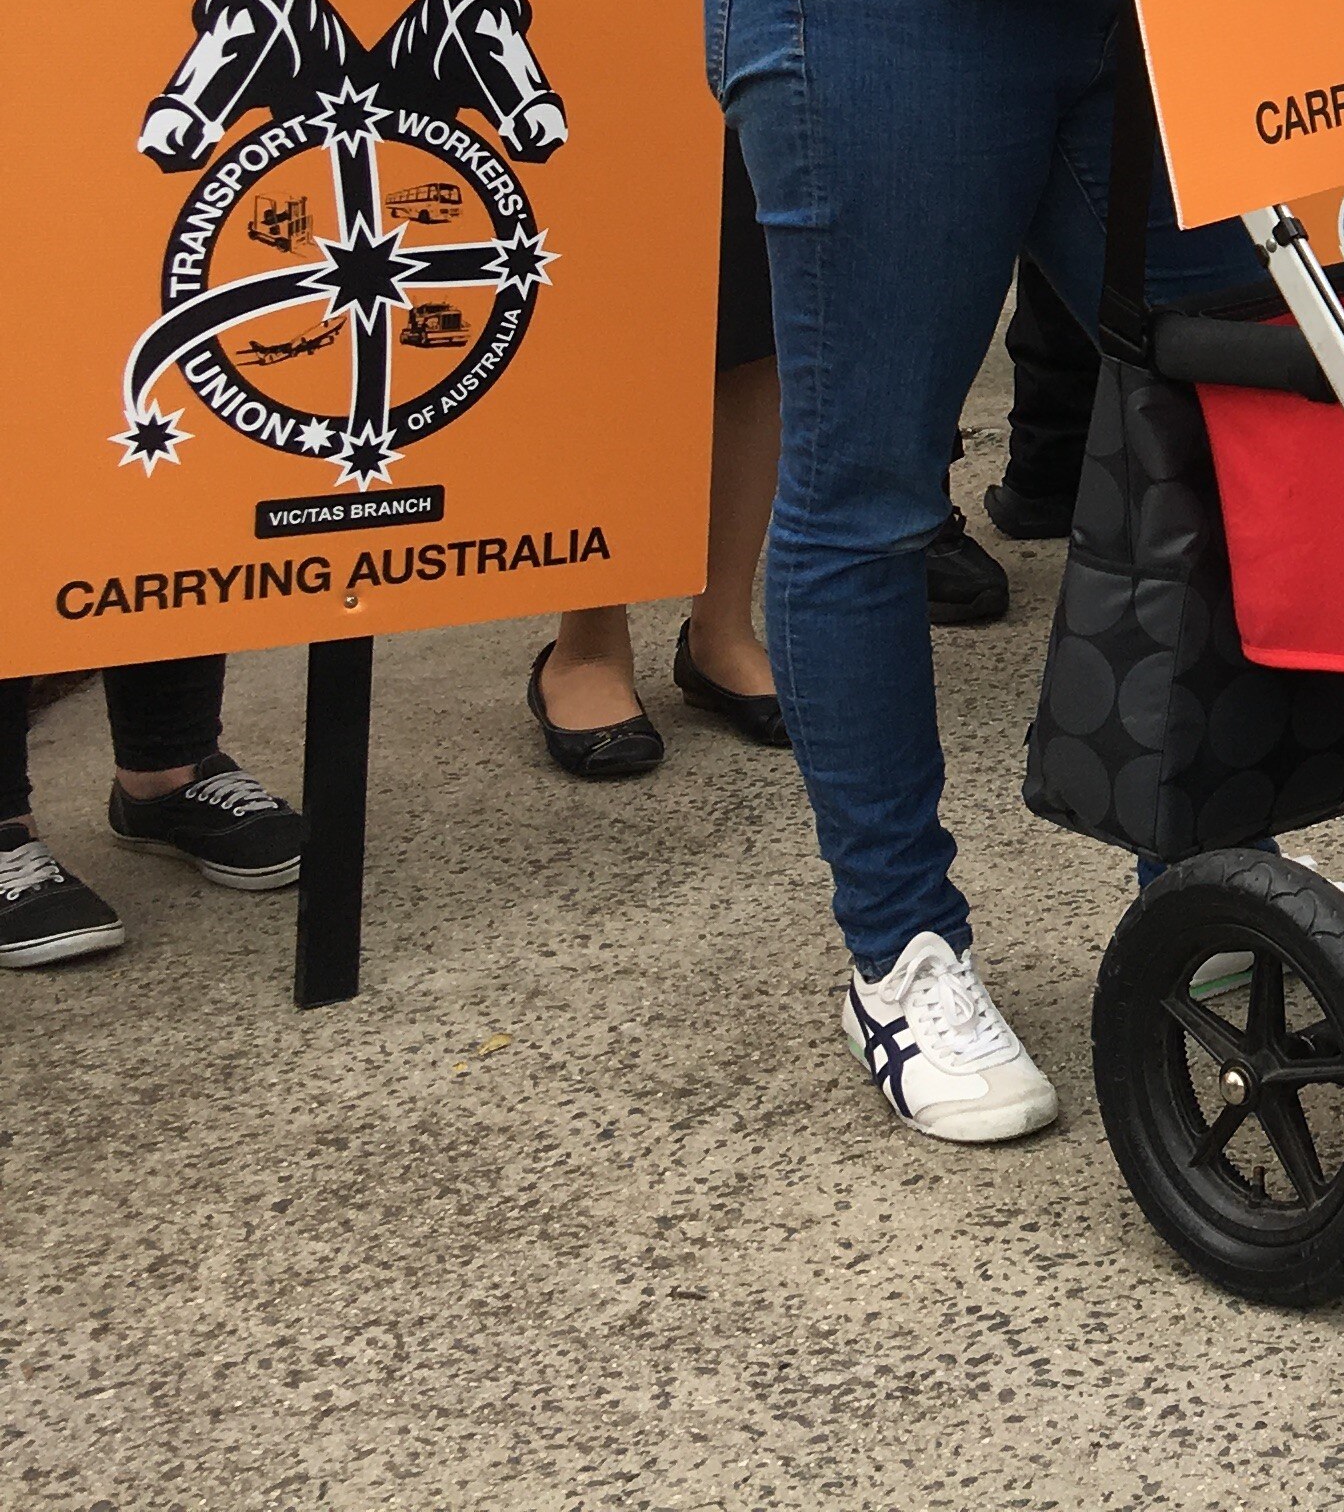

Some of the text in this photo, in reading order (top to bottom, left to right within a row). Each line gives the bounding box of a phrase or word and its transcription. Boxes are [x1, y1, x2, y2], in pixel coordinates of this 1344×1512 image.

[171, 109, 528, 299] TRANSPORT WORKERS'
[185, 308, 522, 448] UNION OF AUSTRALIA
[269, 497, 431, 527] VIC/TAS BRANCH
[55, 527, 610, 621] CARRYING AUSTRALIA
